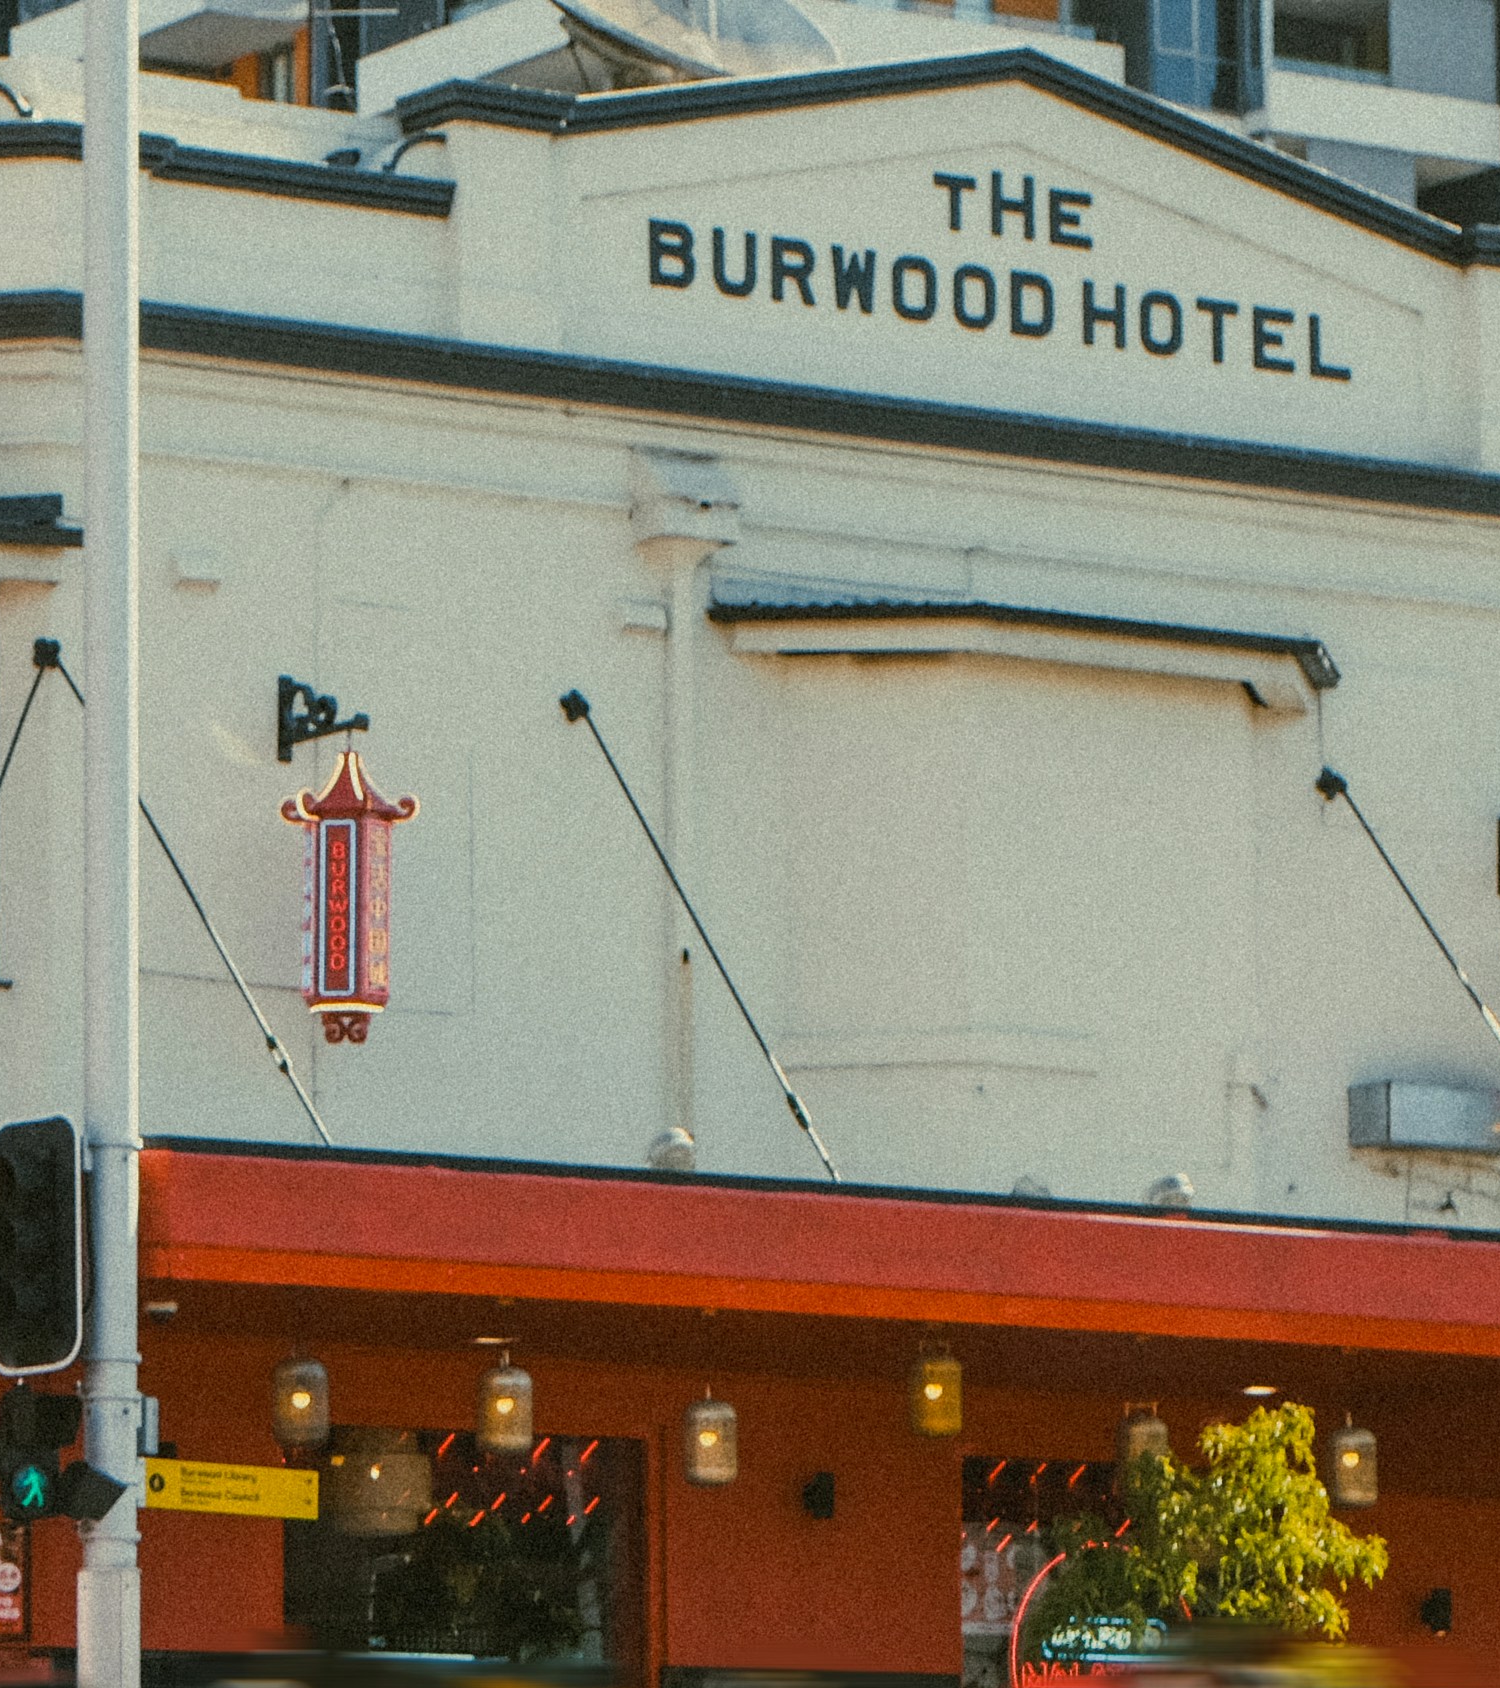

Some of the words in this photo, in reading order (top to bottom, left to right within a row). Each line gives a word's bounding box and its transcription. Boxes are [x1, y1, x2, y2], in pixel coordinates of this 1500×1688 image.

[933, 170, 1094, 250] THE
[648, 217, 1054, 338] BURWOOD
[1082, 280, 1352, 381] HOTEL
[330, 840, 347, 972] BURWOOD
